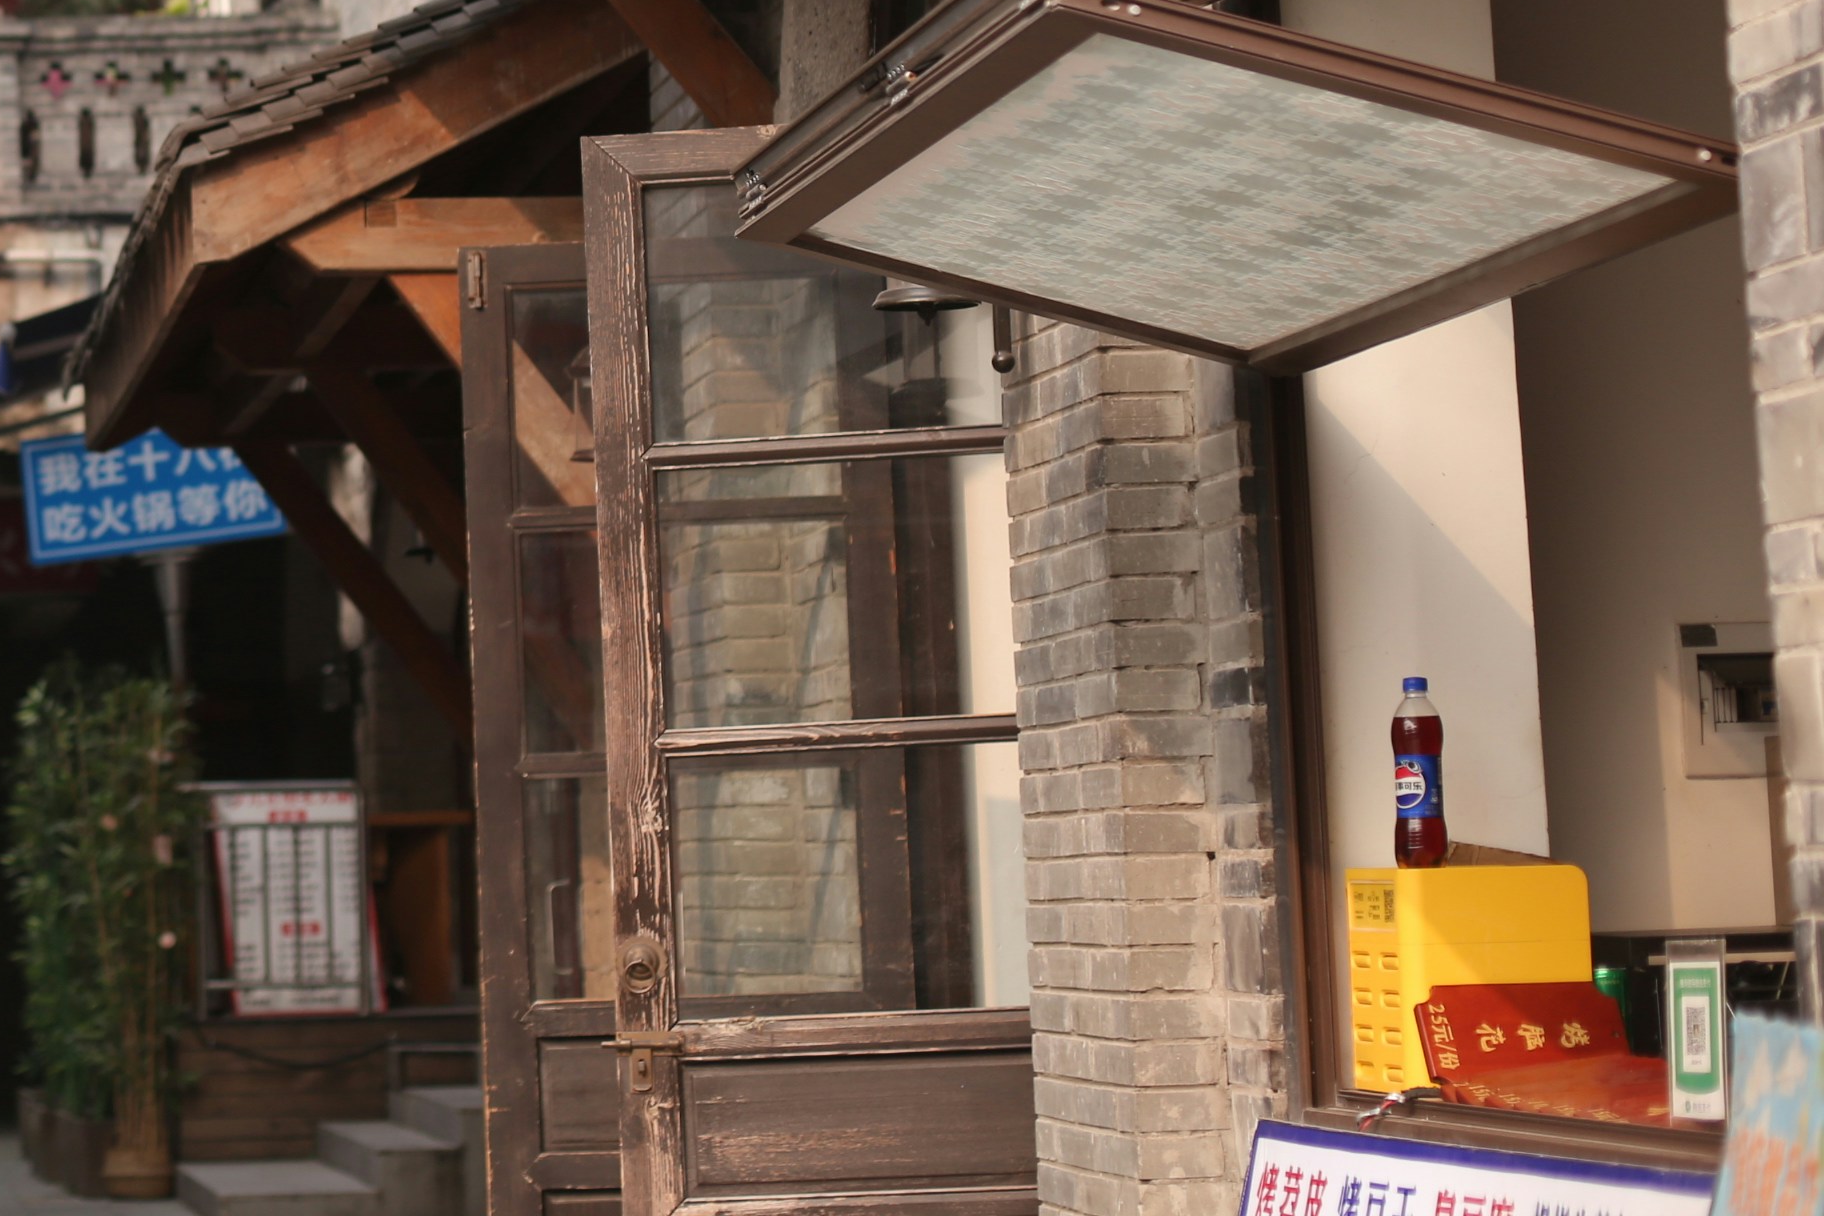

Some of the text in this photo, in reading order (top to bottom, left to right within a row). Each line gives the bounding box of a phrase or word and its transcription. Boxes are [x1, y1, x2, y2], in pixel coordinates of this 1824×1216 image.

[42, 477, 268, 544] 吃火锅等你
[1395, 781, 1424, 791] 事可乐
[1428, 1003, 1460, 1070] 25元/份
[1476, 1022, 1591, 1052] 烤脑花
